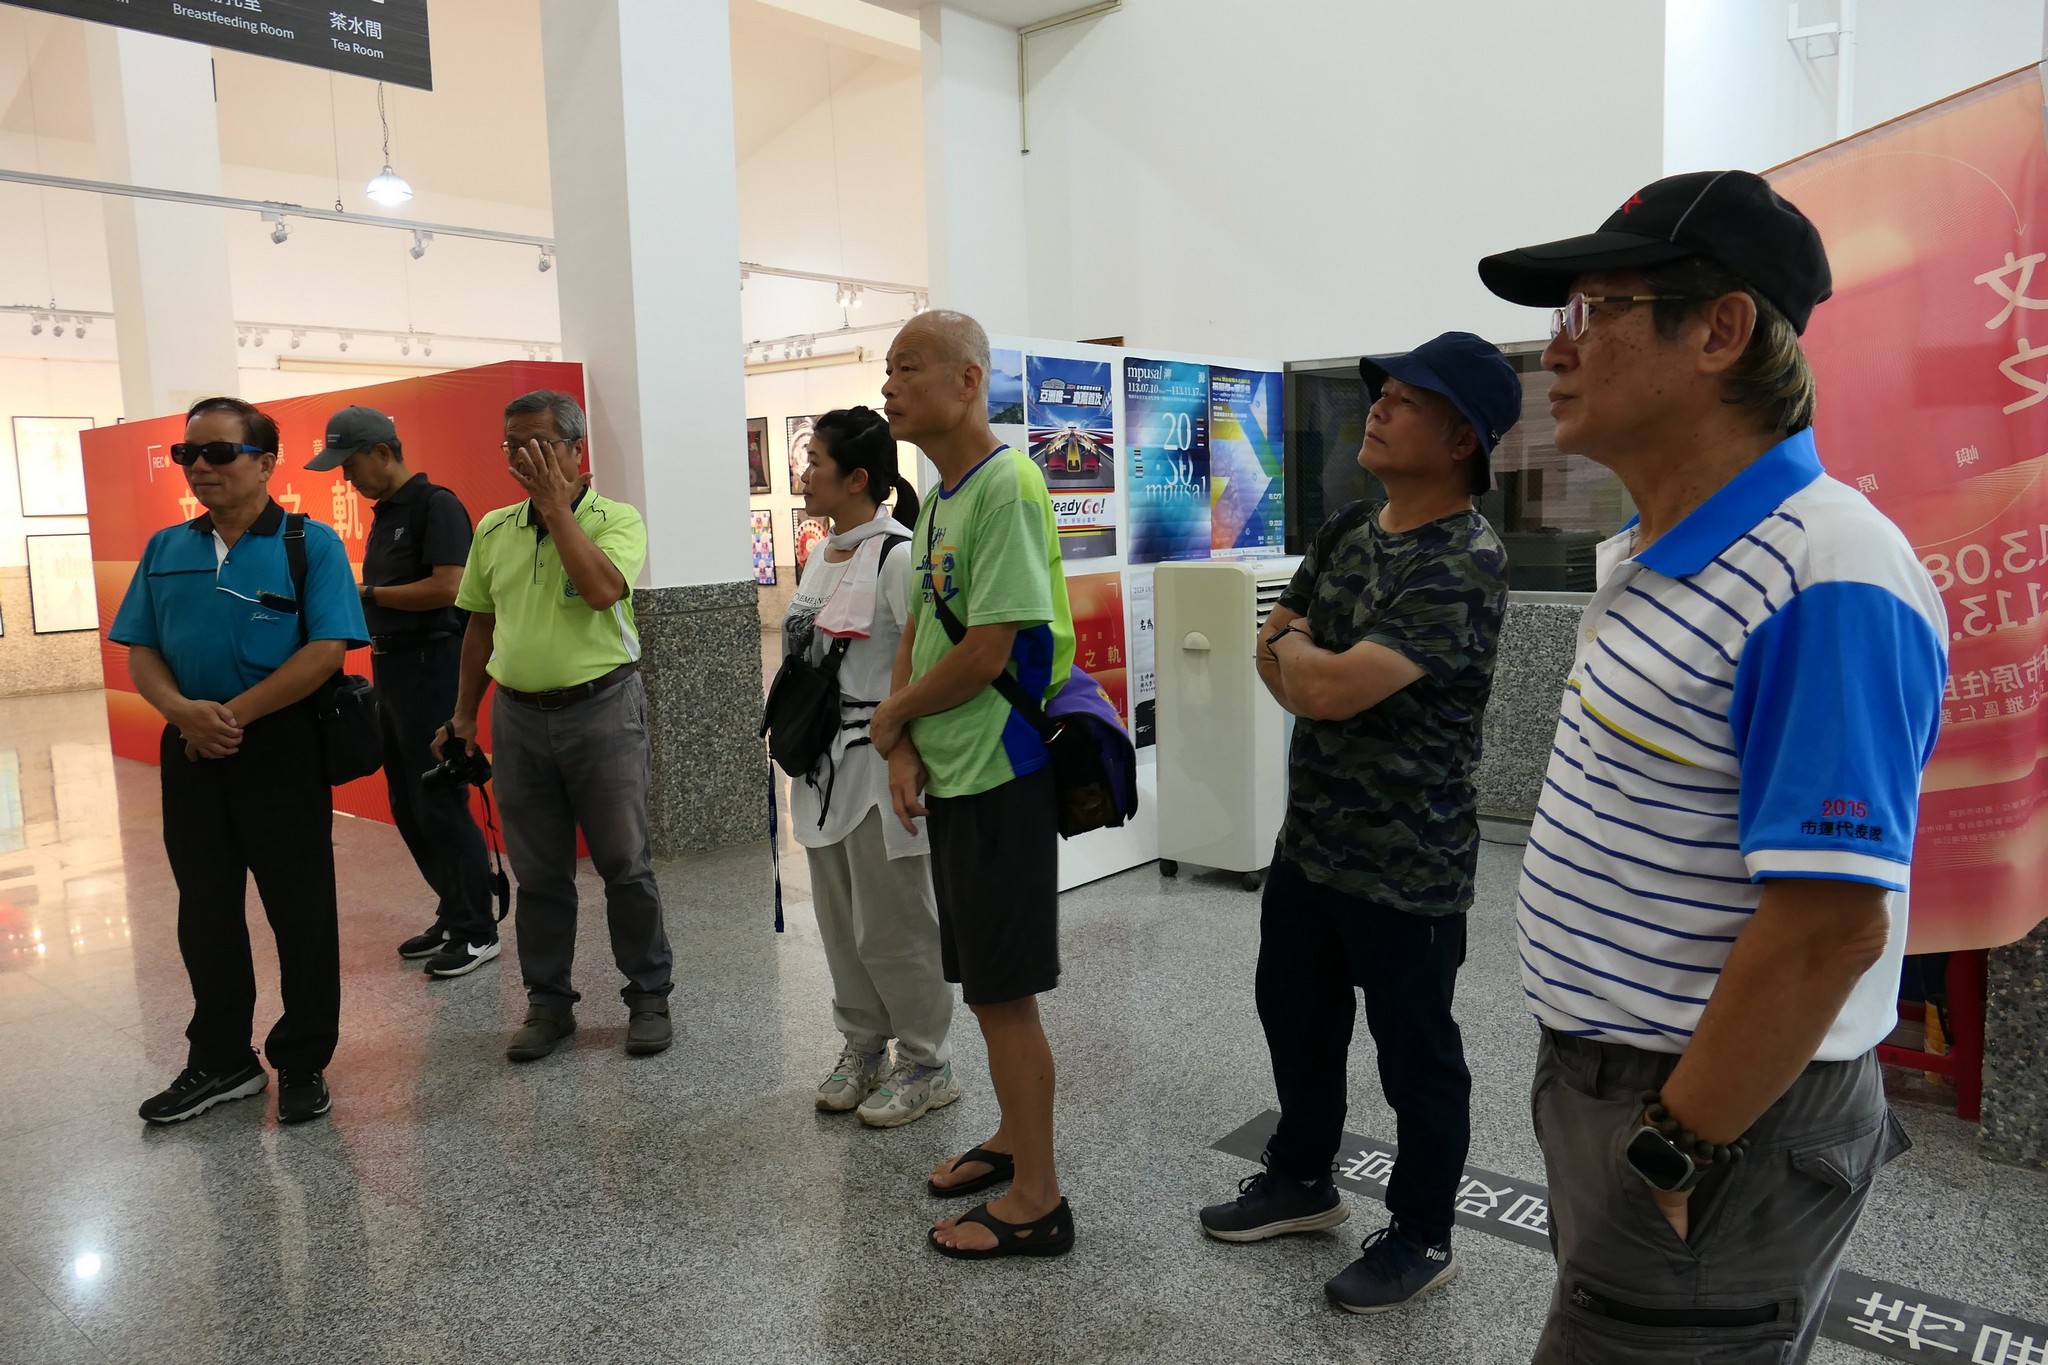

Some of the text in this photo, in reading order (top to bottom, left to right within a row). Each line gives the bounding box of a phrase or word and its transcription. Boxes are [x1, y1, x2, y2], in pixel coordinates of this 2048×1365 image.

[173, 3, 258, 34] Breastfeeding
[260, 21, 295, 40] Room
[329, 11, 382, 40] 茶水間
[331, 38, 384, 60] Tea Room
[1162, 412, 1192, 451] 20
[1051, 499, 1081, 515] eady
[1822, 800, 1868, 818] 2015
